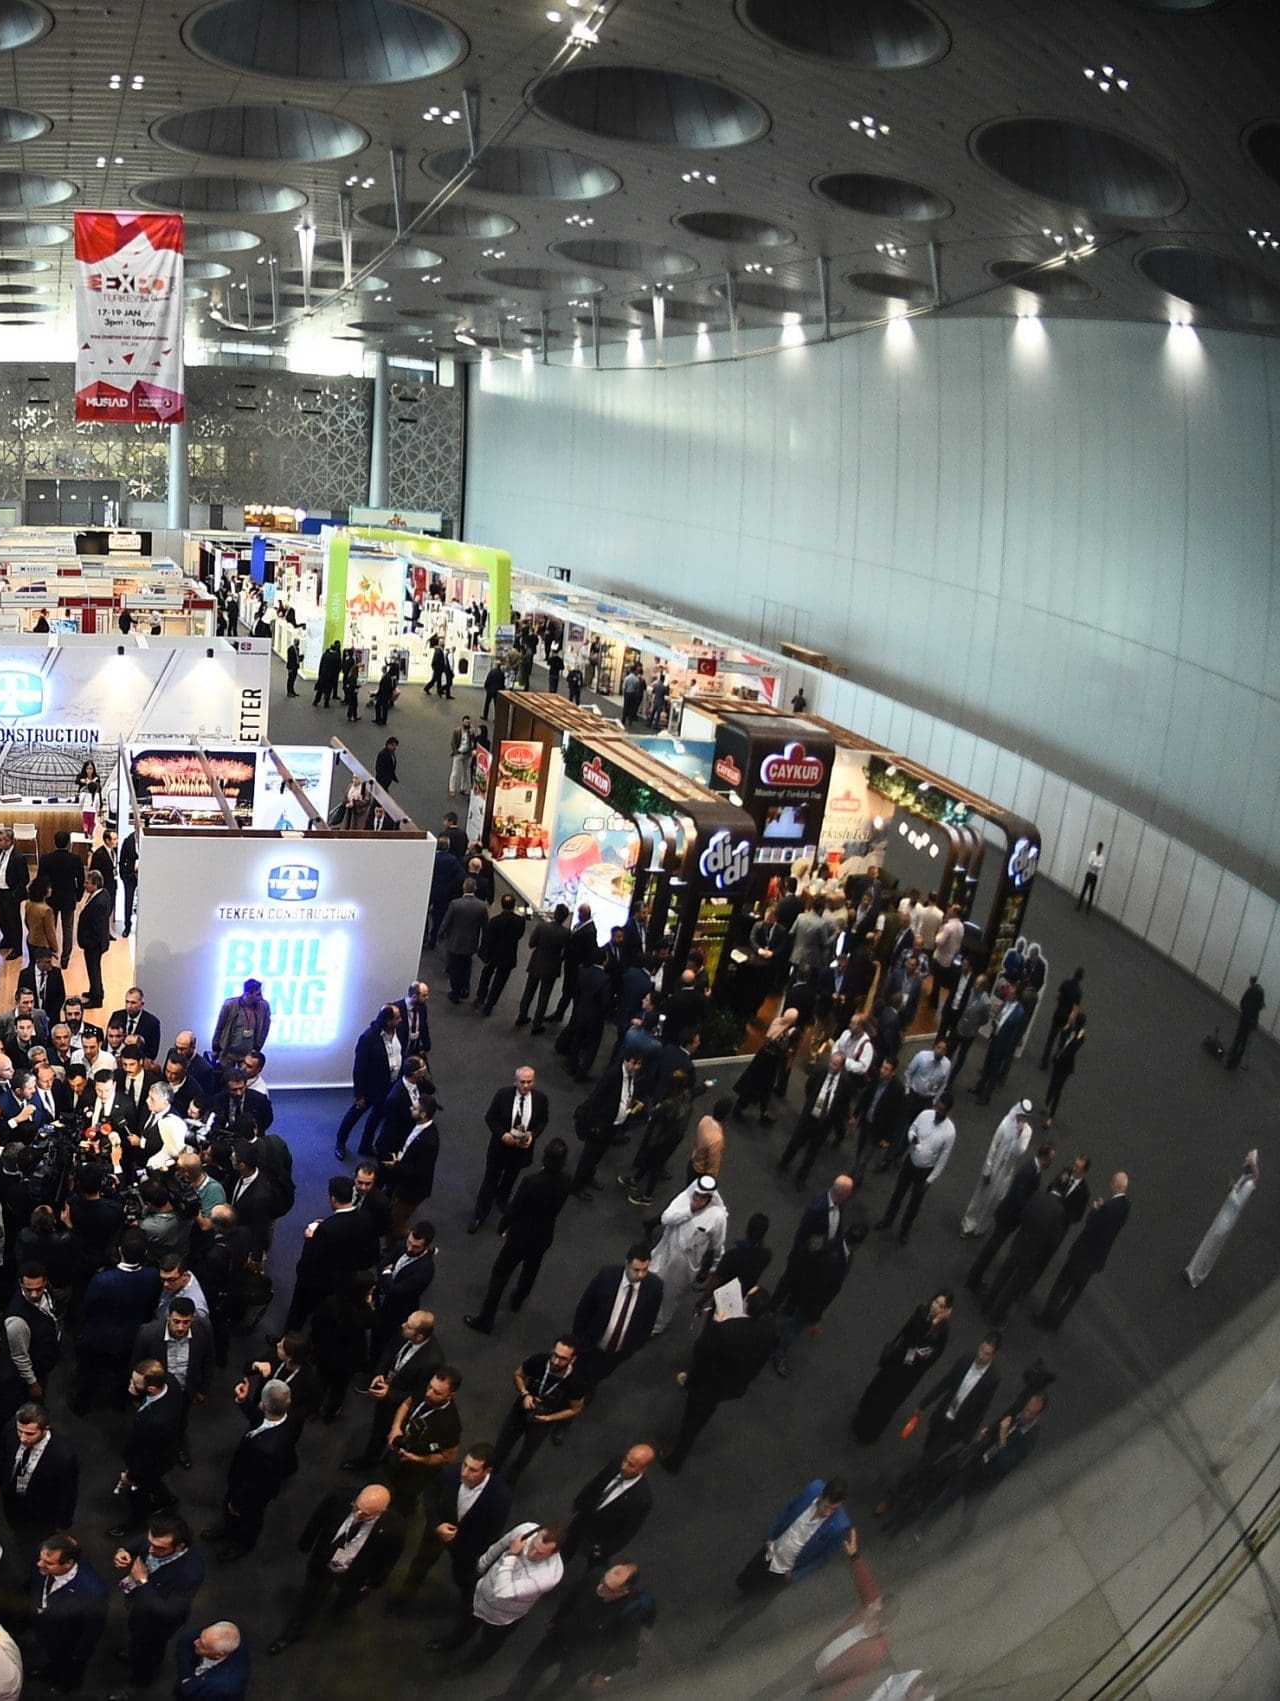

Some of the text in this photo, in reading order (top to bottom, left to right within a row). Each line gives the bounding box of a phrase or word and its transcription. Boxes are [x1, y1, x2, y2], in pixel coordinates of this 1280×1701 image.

[101, 272, 169, 295] EXPO
[104, 319, 123, 327] 3pm
[132, 319, 155, 328] 10pm
[124, 309, 141, 317] JAN
[239, 688, 261, 745] ETTER
[704, 833, 749, 886] didi
[219, 907, 263, 919] TEKFEN
[225, 938, 327, 977] BUIL
